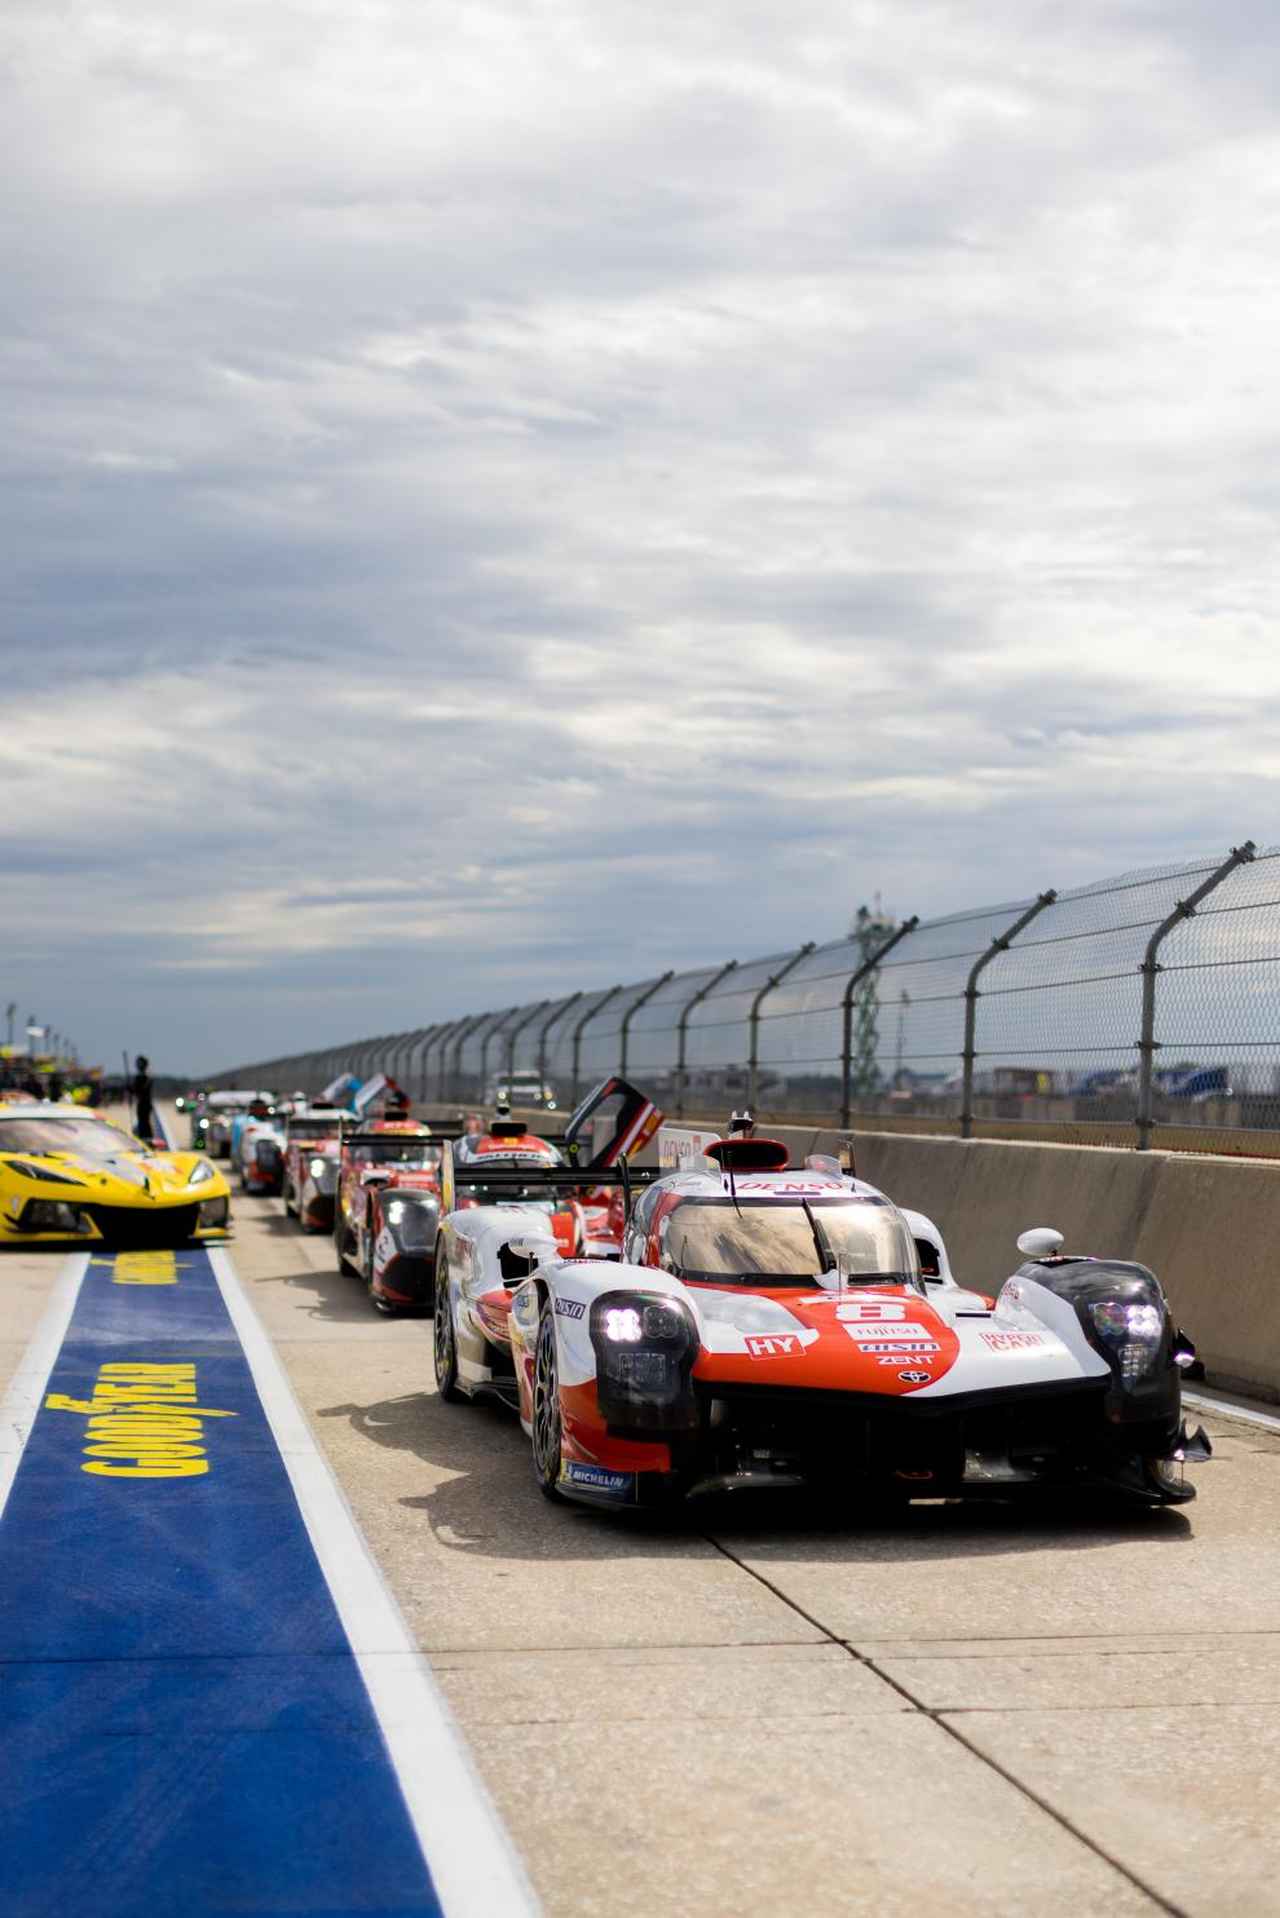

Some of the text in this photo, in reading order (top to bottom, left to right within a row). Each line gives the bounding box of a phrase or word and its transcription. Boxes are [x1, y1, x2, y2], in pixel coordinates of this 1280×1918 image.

[736, 1182, 843, 1191] DENSO
[835, 1304, 905, 1320] 8
[750, 1337, 793, 1355] HY
[876, 1356, 934, 1364] ZENT
[80, 1363, 210, 1478] GOODYEAR
[572, 1470, 625, 1487] MICHELIN
